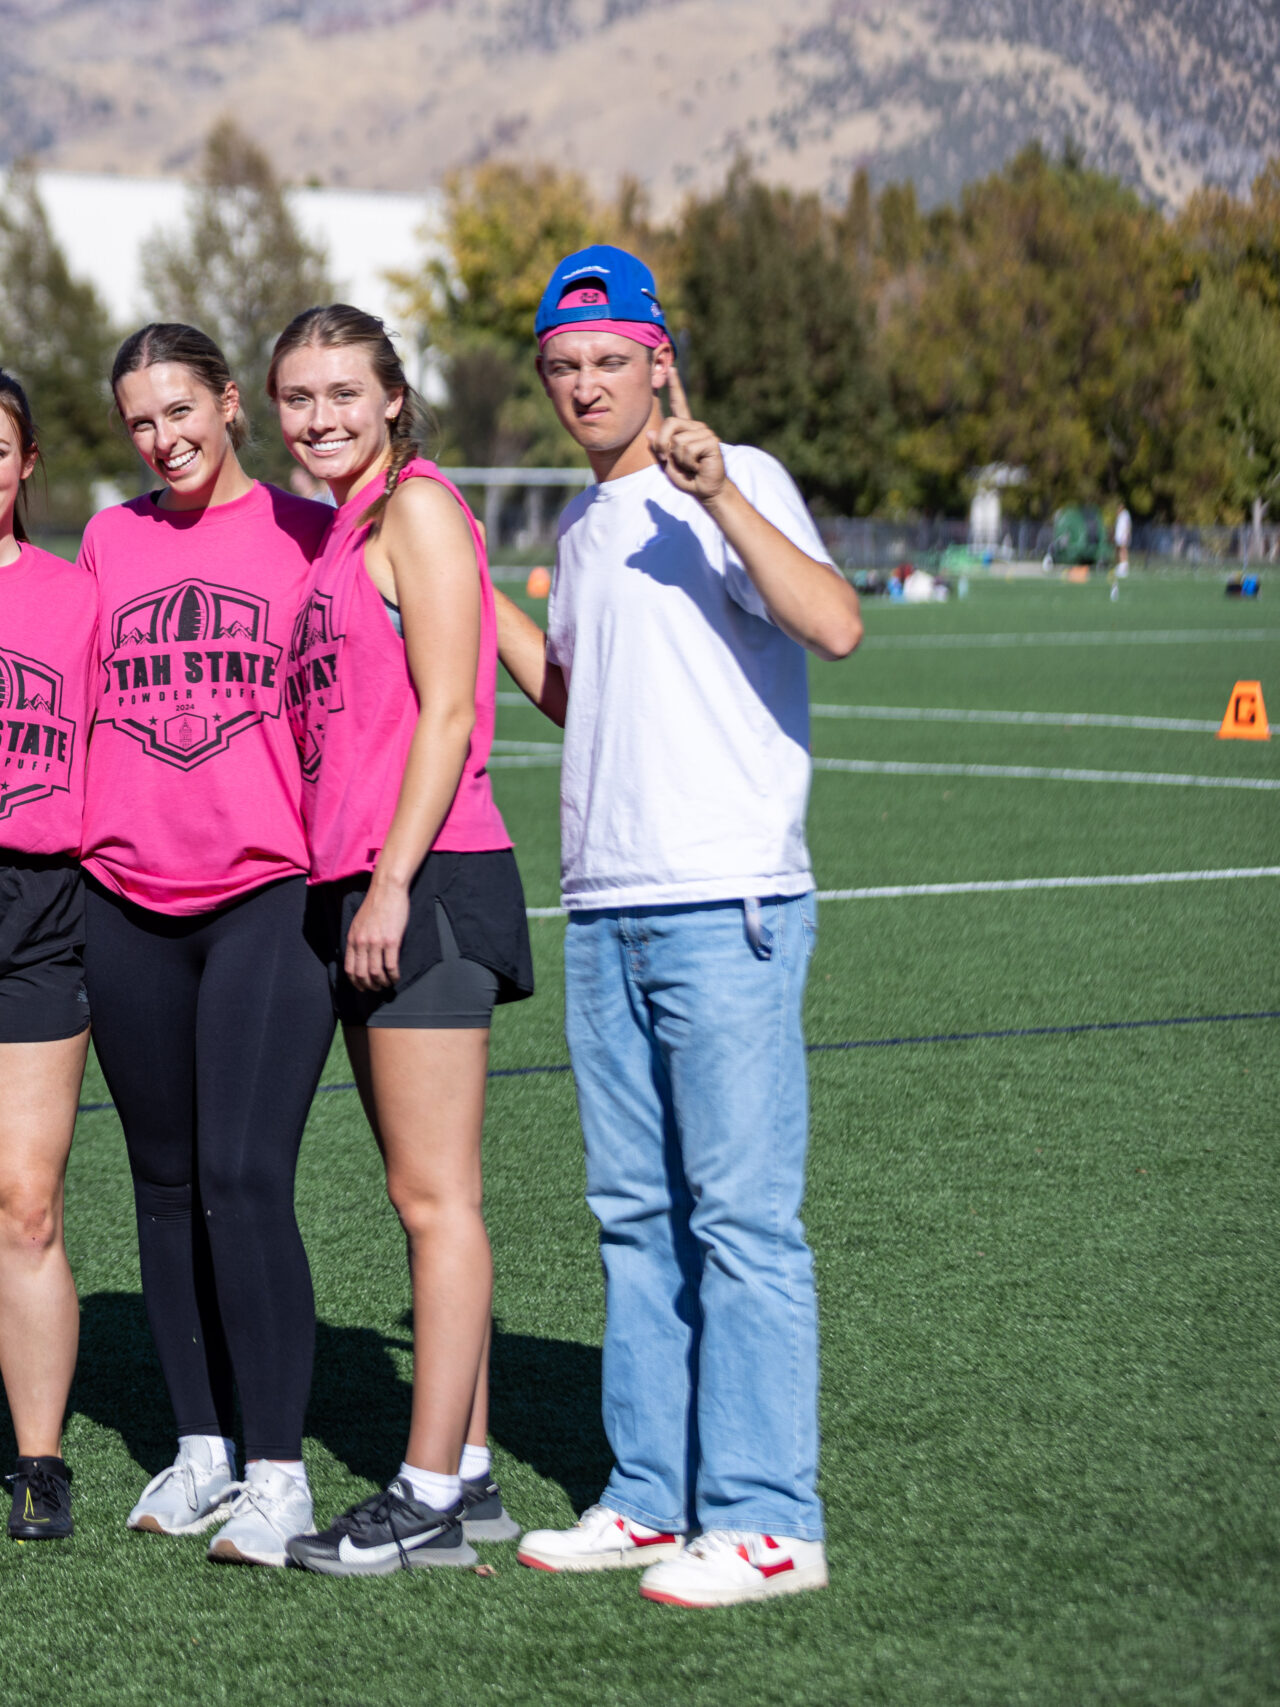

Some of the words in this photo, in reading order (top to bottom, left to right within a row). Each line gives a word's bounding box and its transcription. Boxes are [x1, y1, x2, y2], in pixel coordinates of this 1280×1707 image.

[183, 651, 276, 688] STATE
[119, 689, 193, 707] POWDER
[211, 688, 256, 699] PUFF
[175, 703, 195, 712] 2024
[4, 757, 50, 773] PUFF
